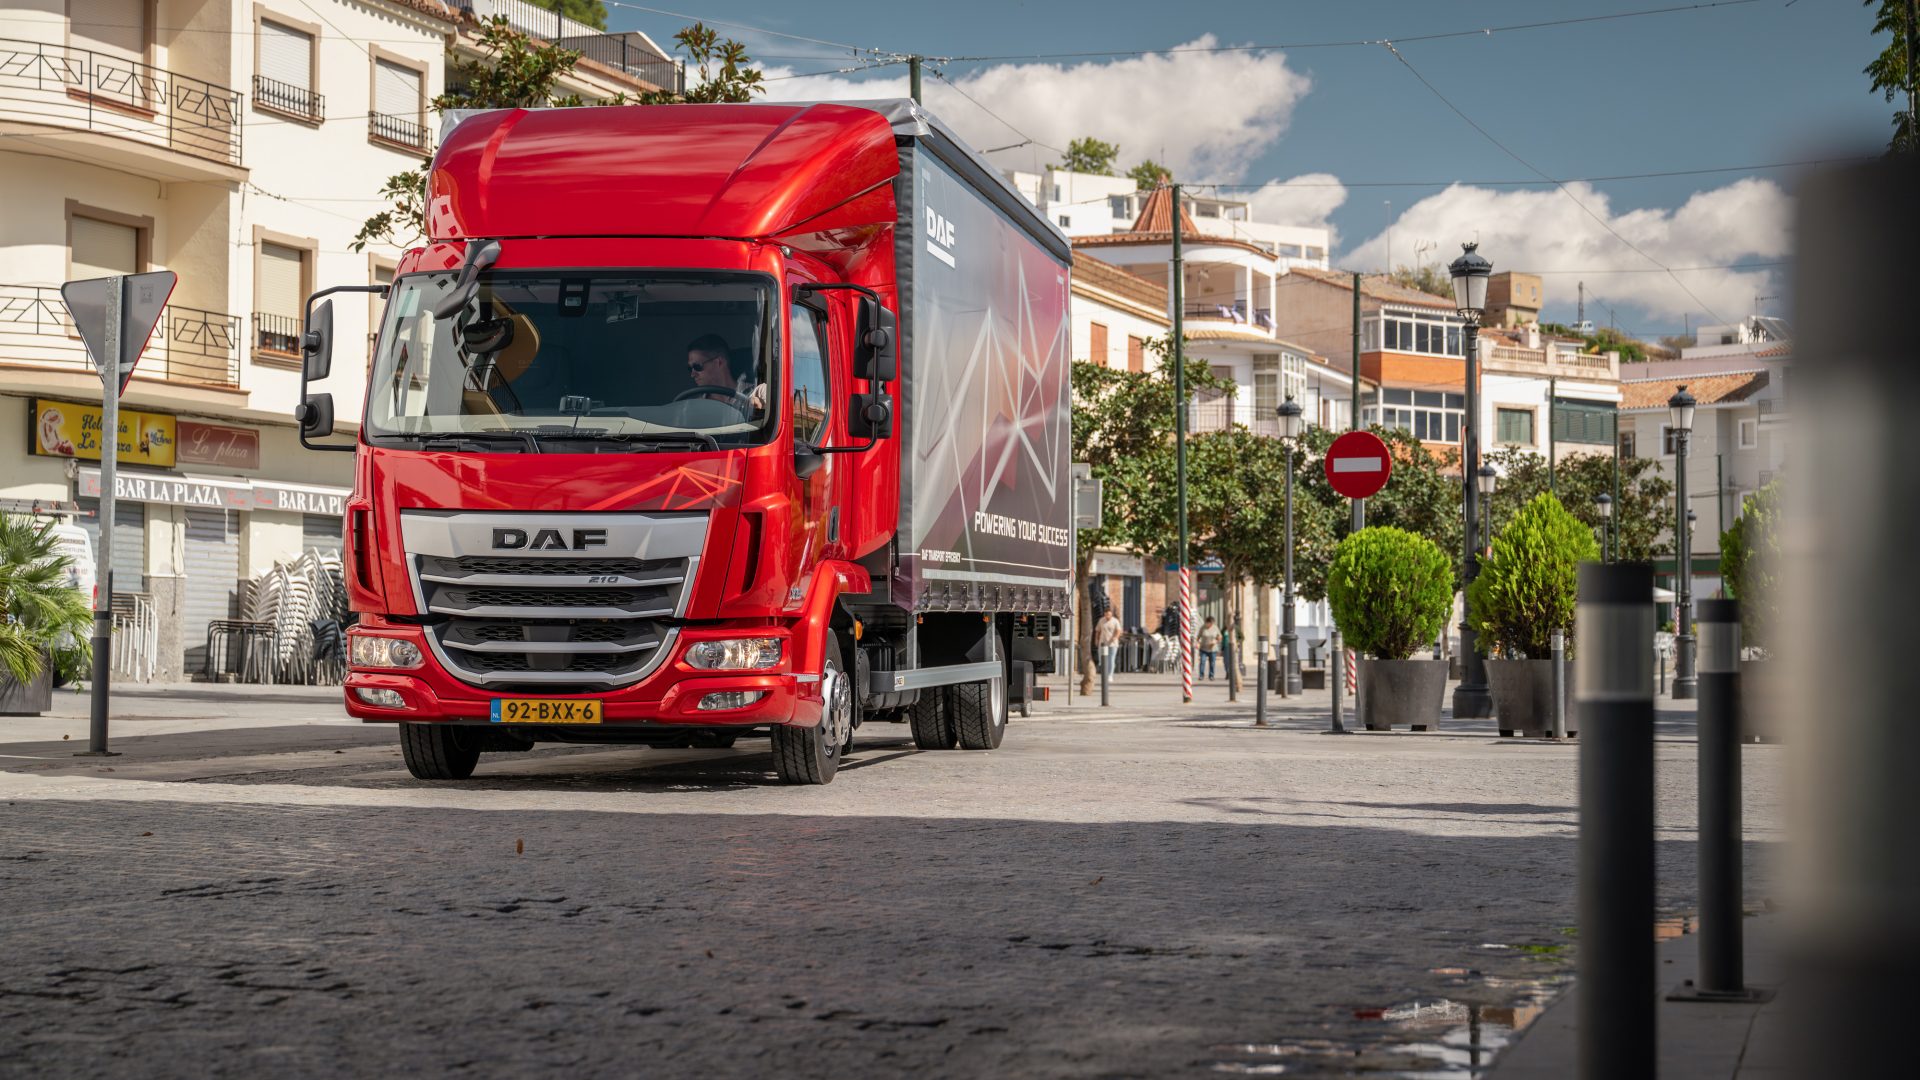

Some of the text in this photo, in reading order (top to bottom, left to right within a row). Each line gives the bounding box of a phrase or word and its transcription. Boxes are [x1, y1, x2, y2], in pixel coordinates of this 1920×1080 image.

[926, 205, 955, 249] DAF
[77, 431, 95, 449] La
[187, 427, 209, 455] La
[115, 478, 147, 499] BAR
[150, 481, 171, 502] LA
[173, 482, 222, 506] PLAZA
[278, 490, 307, 511] BAR
[309, 493, 327, 513] LA
[492, 527, 608, 551] DAF
[974, 511, 1068, 547] POWERING YOUR SUCCESS
[588, 576, 619, 584] 210
[507, 702, 594, 720] 92-BXX-6
